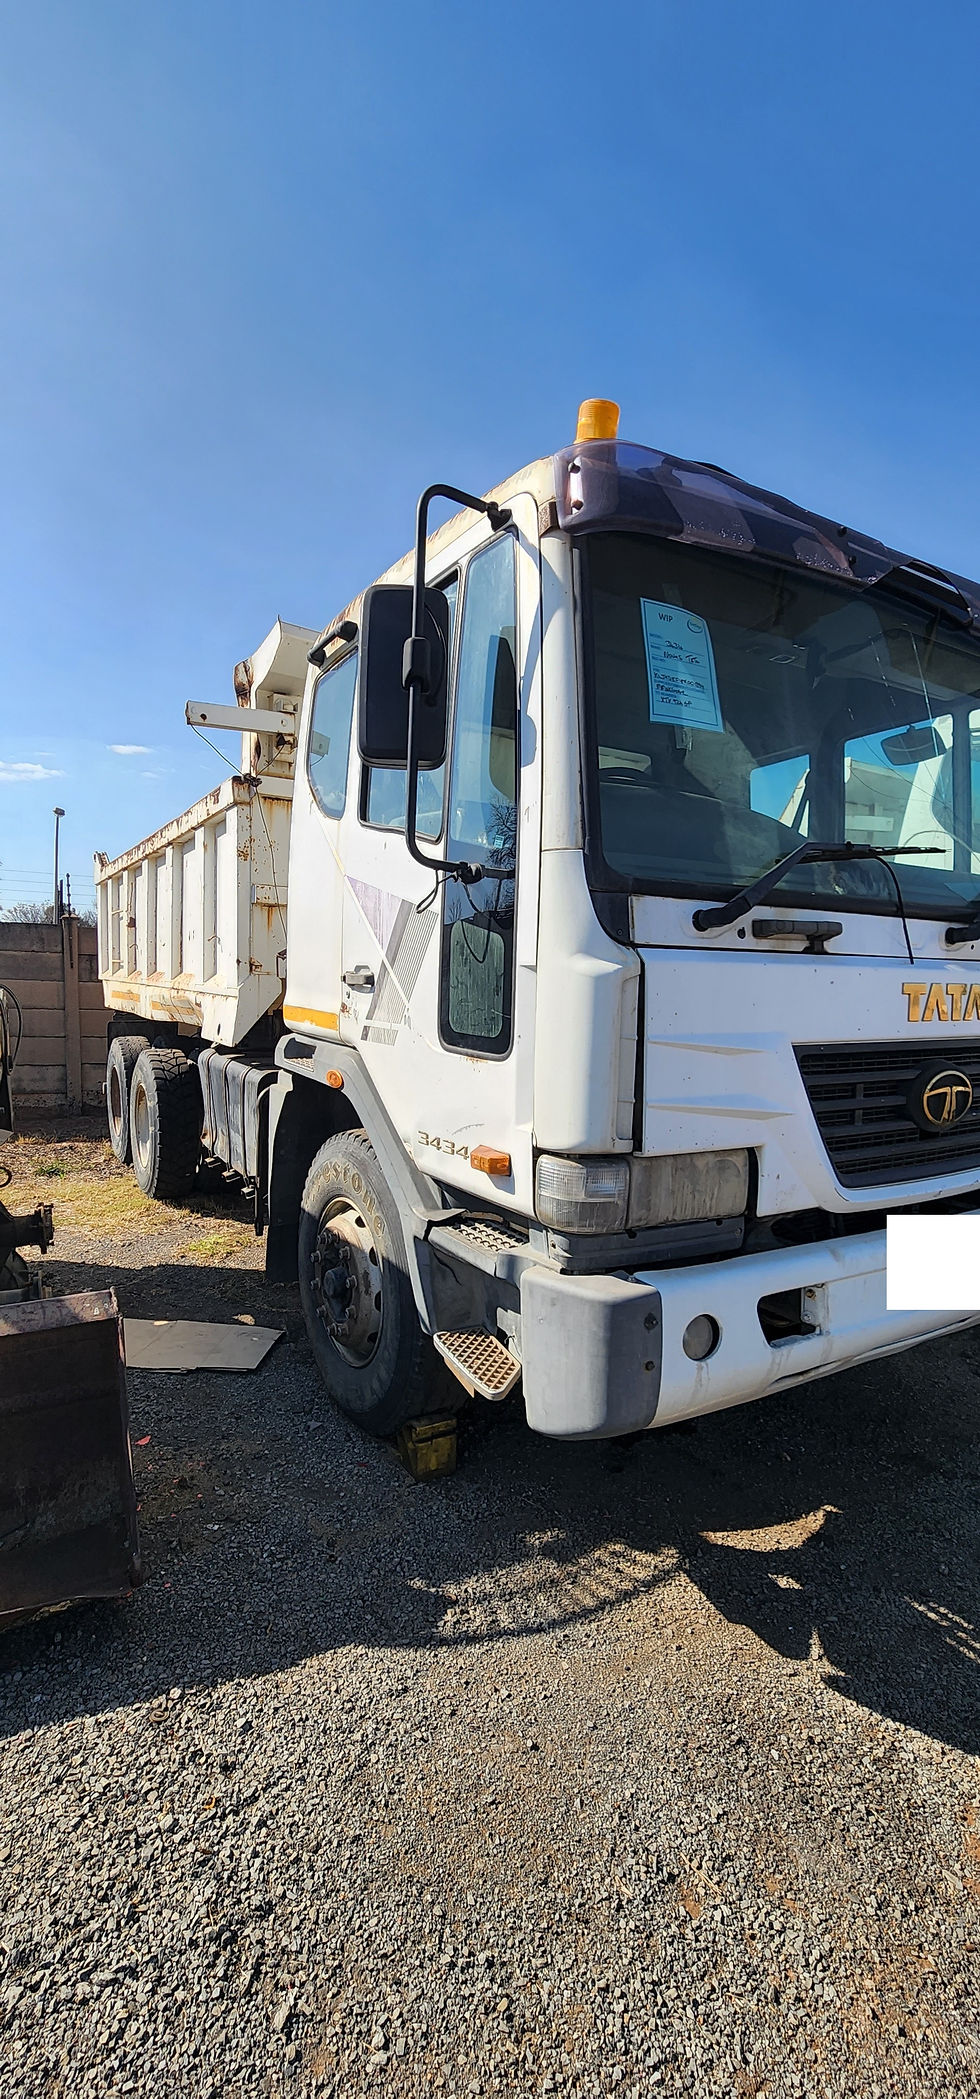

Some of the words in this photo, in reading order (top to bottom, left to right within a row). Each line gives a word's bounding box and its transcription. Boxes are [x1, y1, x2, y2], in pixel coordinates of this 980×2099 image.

[658, 612, 673, 623] WIP
[902, 982, 980, 1022] TATA
[417, 1130, 470, 1161] 3434
